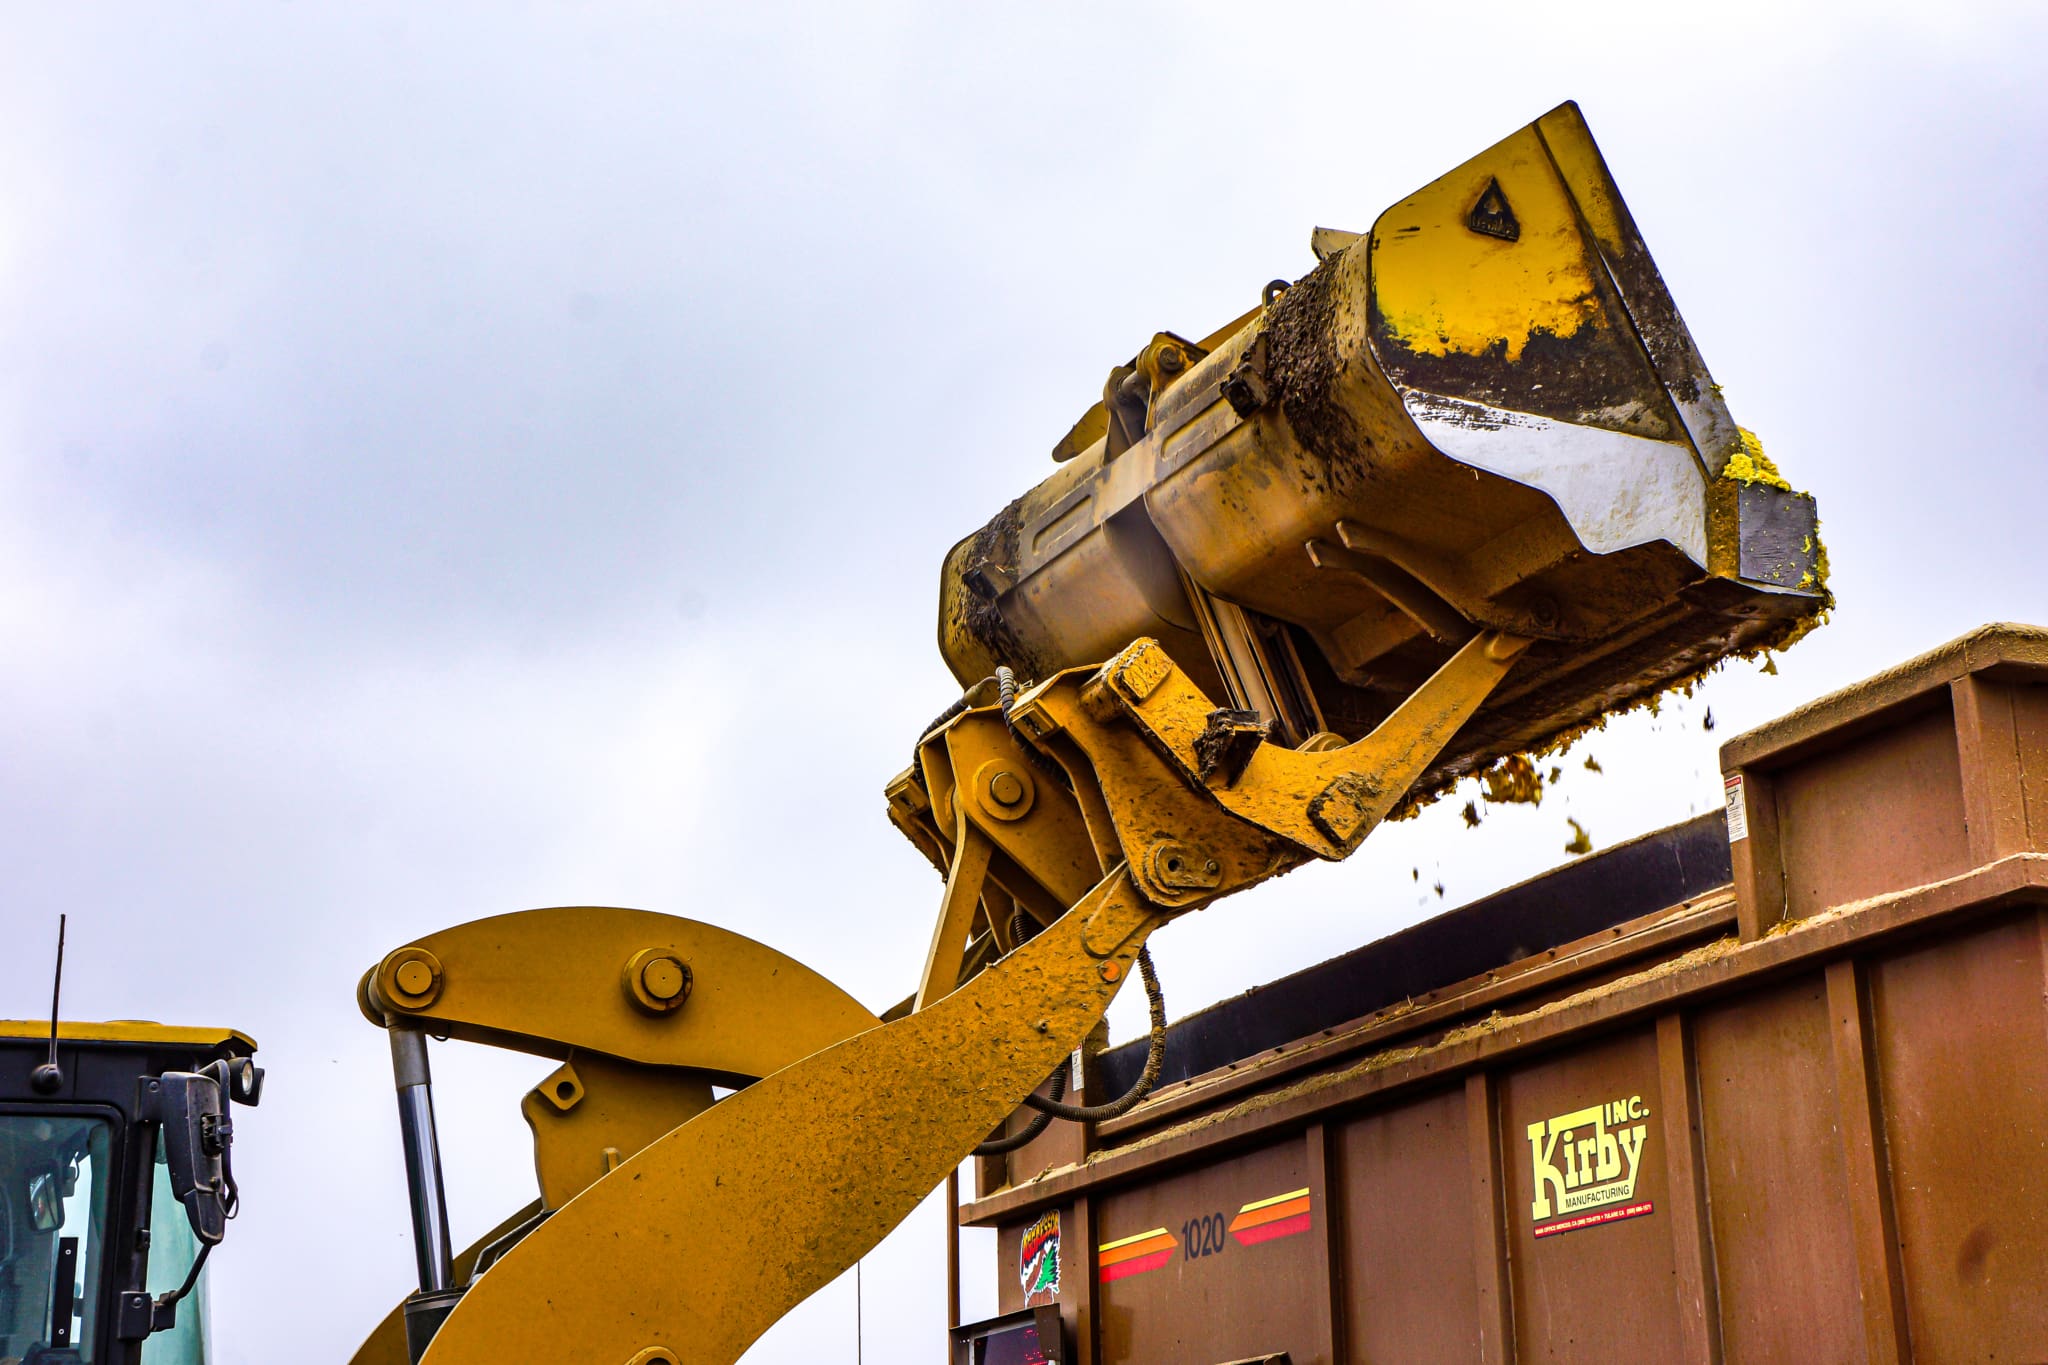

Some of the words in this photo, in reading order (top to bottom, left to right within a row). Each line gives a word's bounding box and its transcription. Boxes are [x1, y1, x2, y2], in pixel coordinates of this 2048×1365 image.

[1605, 1095, 1650, 1127] INC.
[1527, 1105, 1647, 1220] Kirby
[1565, 1184, 1629, 1208] MANUFACTURING
[1181, 1211, 1225, 1261] 1020
